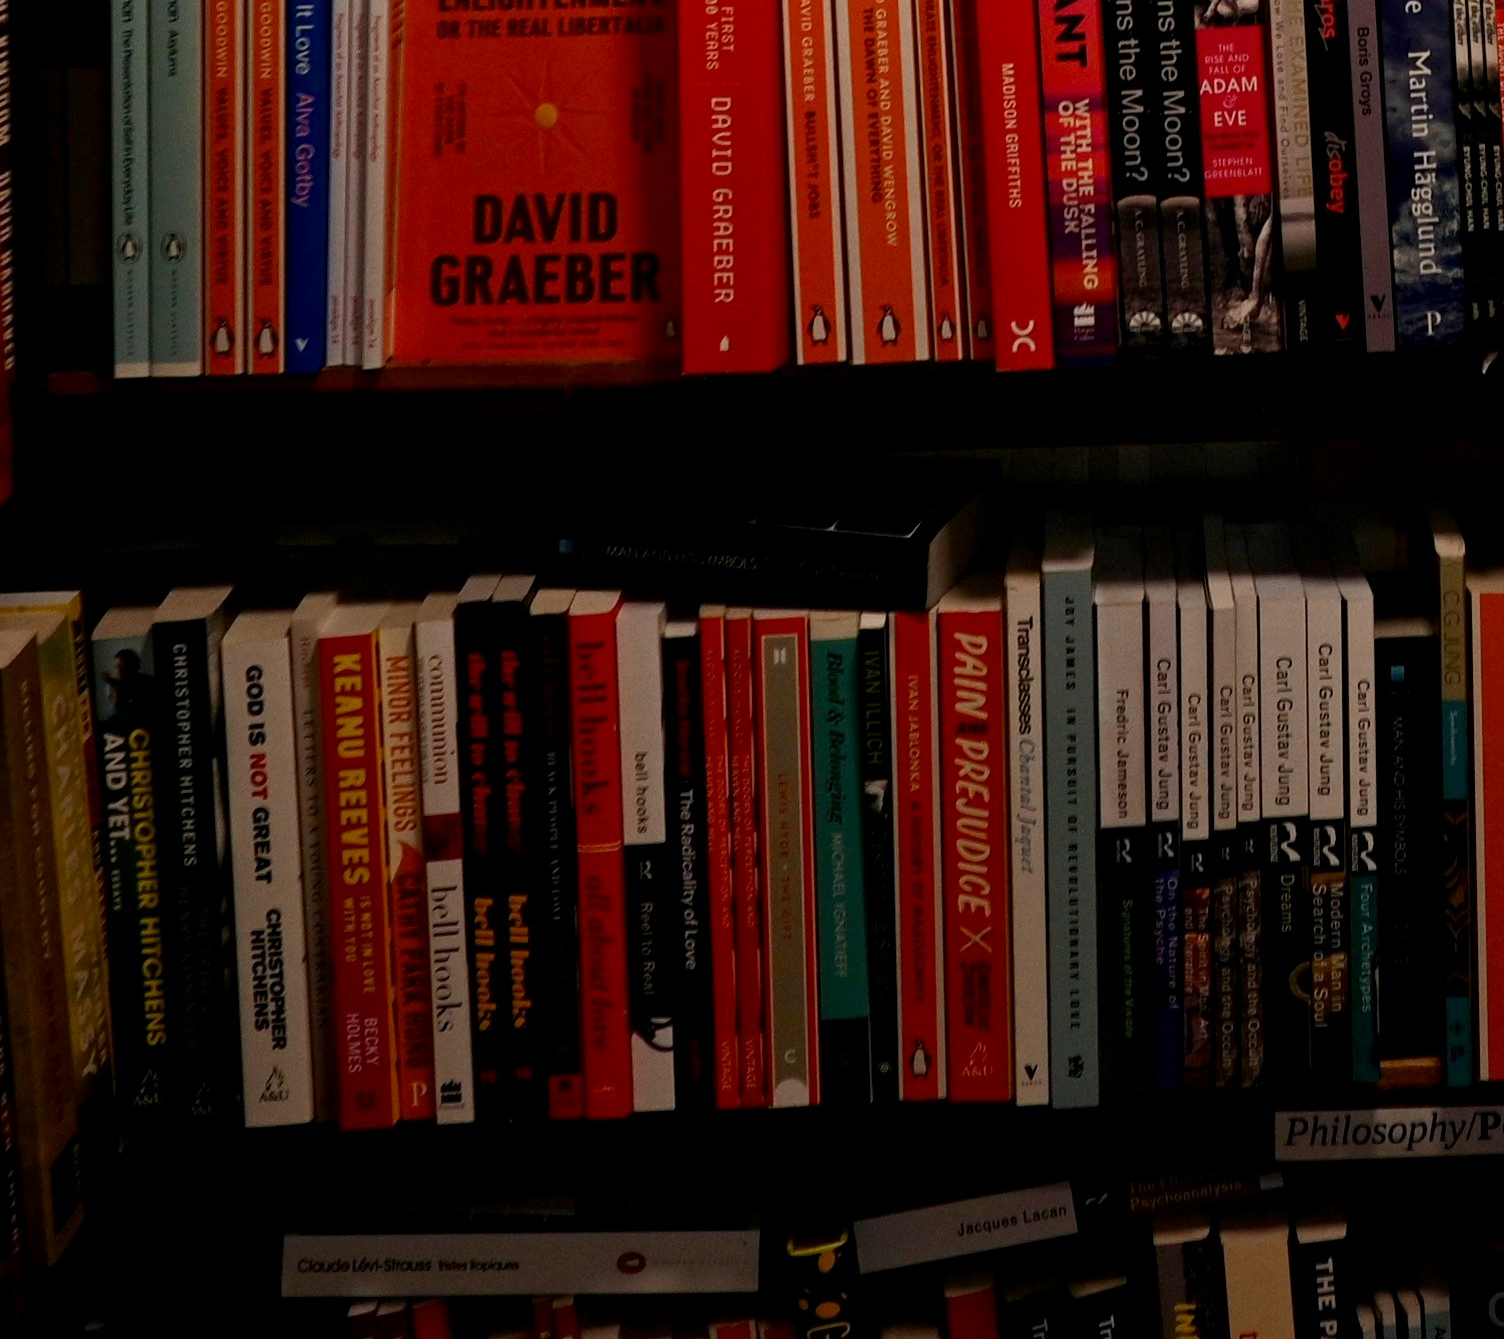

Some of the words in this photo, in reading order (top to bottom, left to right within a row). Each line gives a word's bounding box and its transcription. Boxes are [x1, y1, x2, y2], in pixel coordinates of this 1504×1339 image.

[1199, 76, 1258, 95] ADAM
[1212, 110, 1247, 126] EVE
[473, 192, 618, 245] DAVID
[429, 253, 662, 308] GRAEBER
[331, 653, 363, 757] KEANU
[338, 766, 371, 887] REEVES
